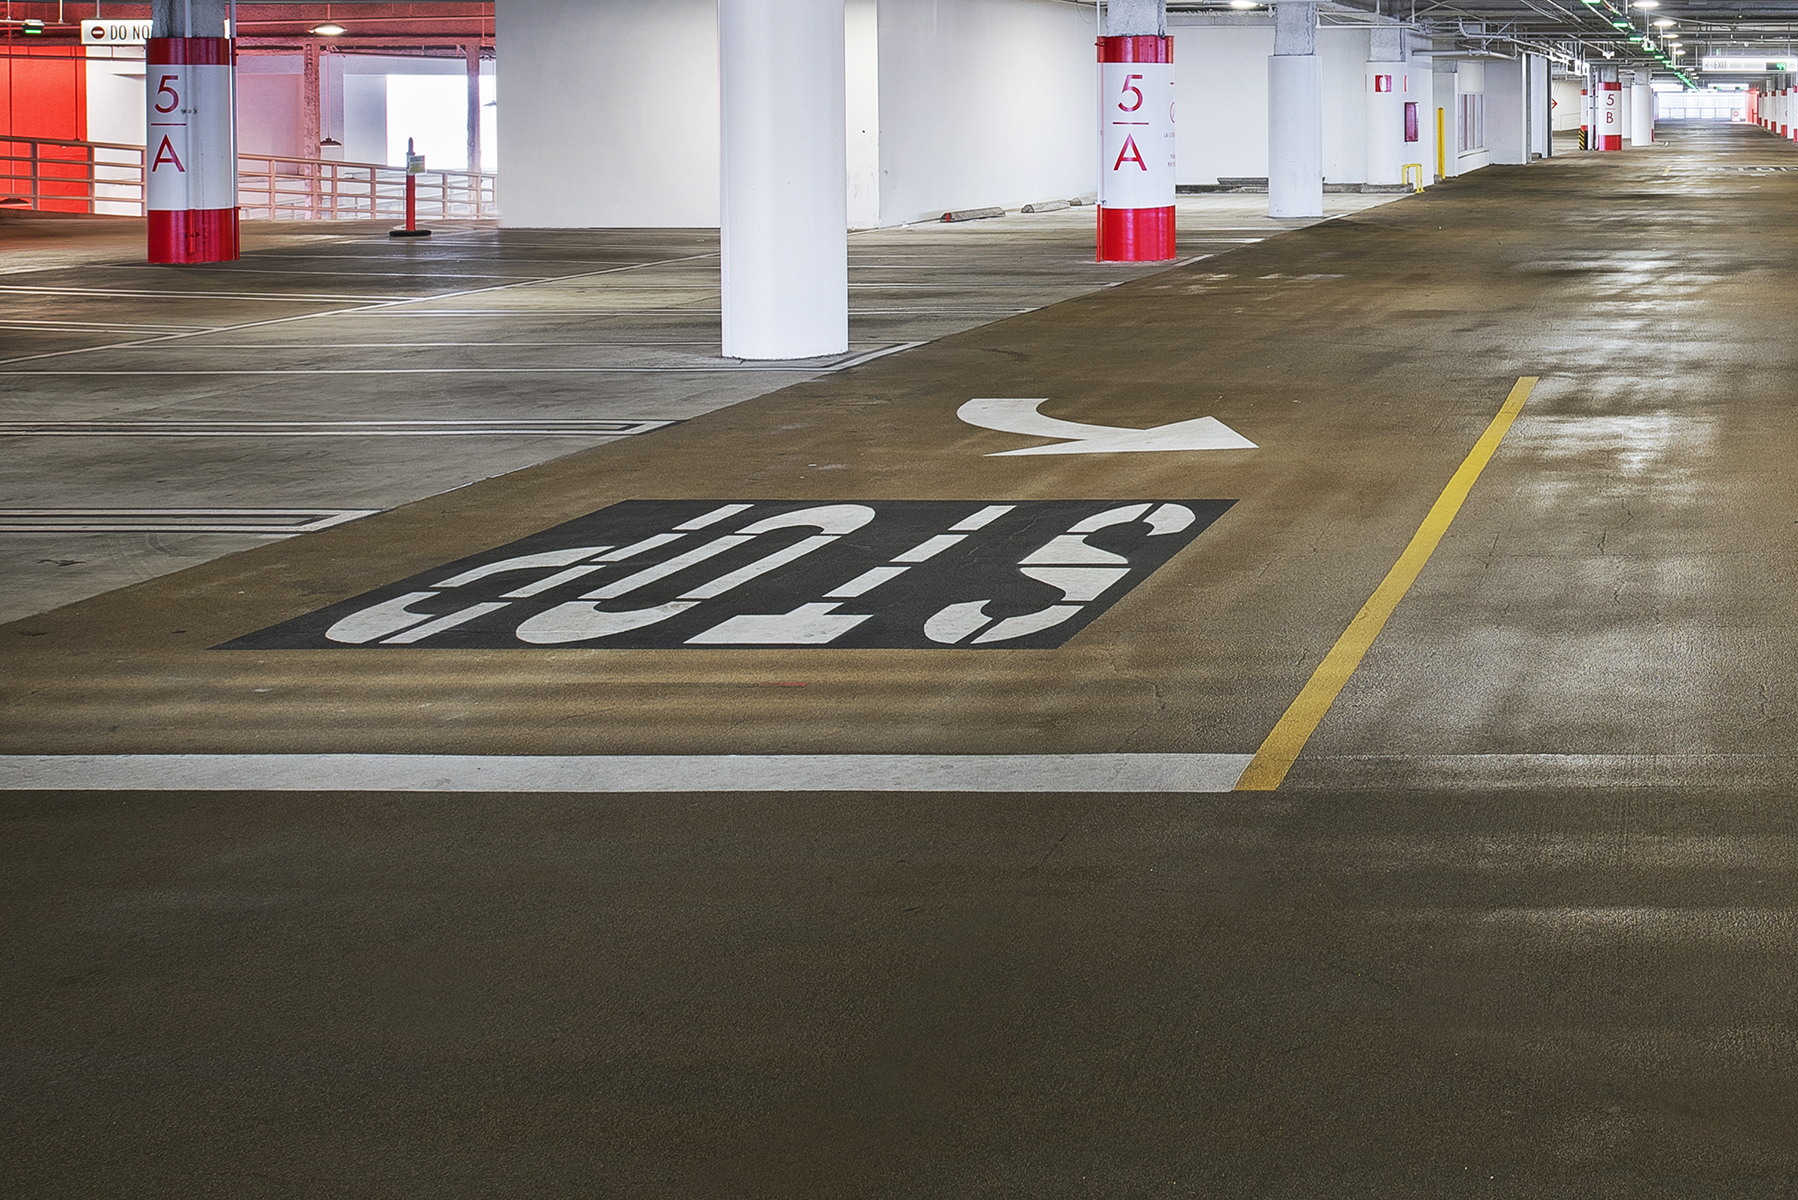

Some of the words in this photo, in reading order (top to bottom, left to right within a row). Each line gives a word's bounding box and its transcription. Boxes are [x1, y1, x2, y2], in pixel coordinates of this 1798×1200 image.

[110, 25, 128, 40] DO
[153, 74, 180, 113] 5
[1117, 74, 1143, 112] 5
[1606, 93, 1615, 106] 5
[1606, 111, 1614, 124] B
[151, 133, 186, 173] A
[1113, 132, 1148, 171] A
[324, 503, 1196, 645] STOP
